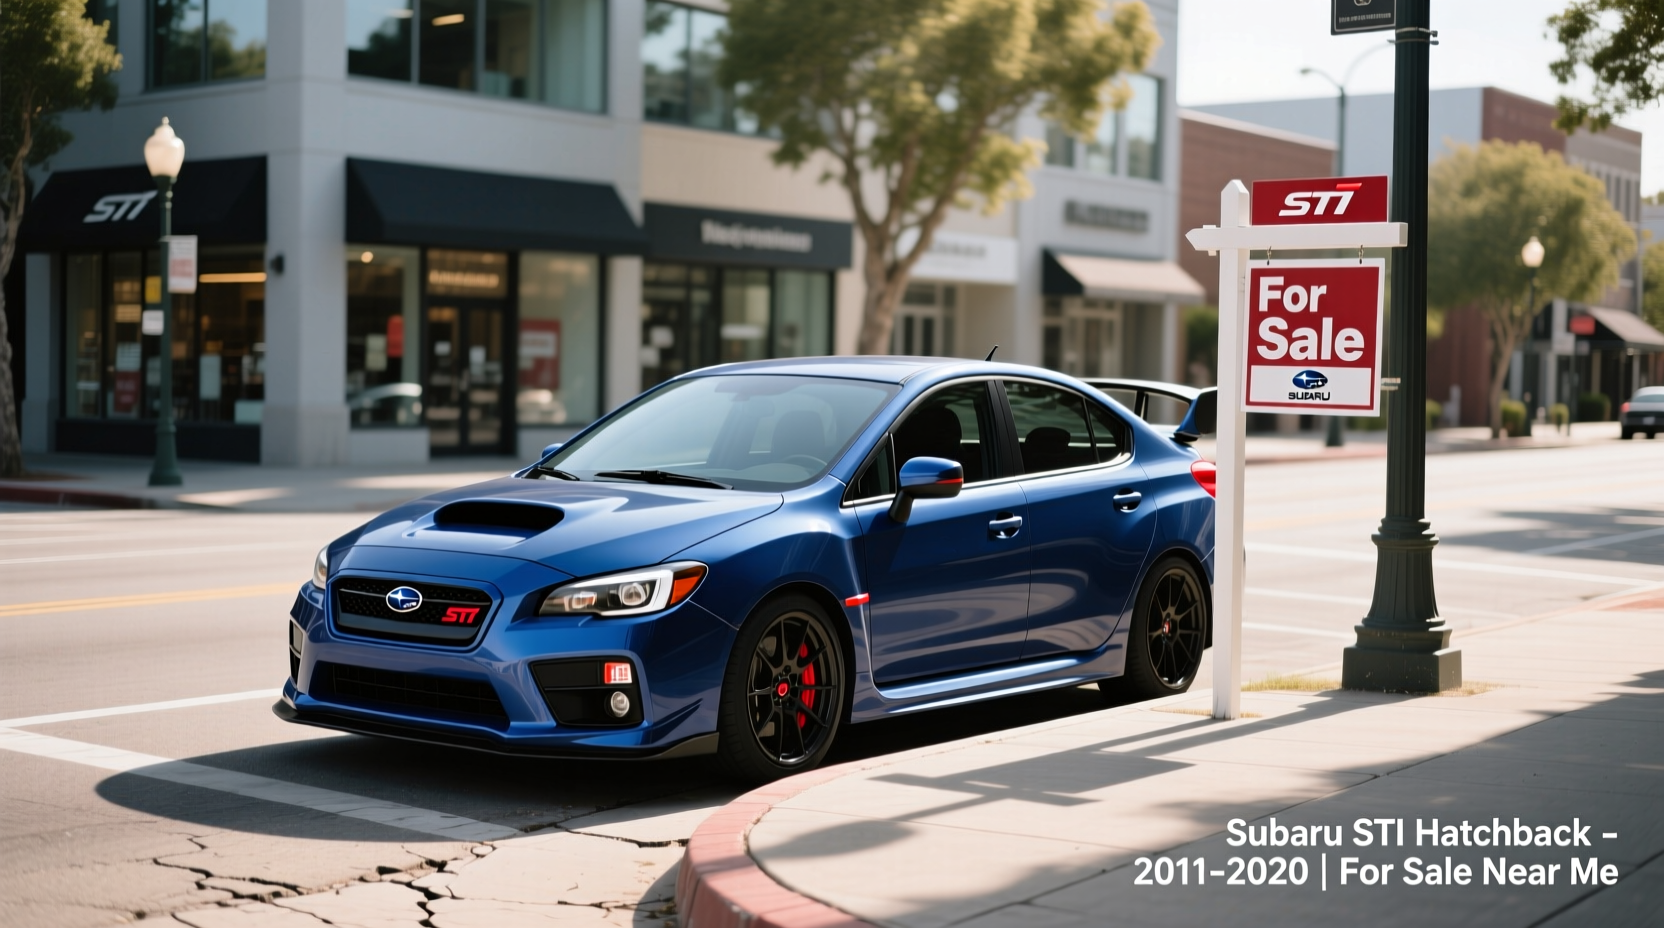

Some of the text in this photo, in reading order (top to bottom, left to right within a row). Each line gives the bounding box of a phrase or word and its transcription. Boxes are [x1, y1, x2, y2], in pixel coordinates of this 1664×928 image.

[83, 189, 158, 223] STI
[1278, 182, 1363, 217] STI
[1258, 275, 1328, 313] For
[1256, 316, 1366, 362] Sale
[1288, 391, 1331, 401] SUBARU
[441, 606, 481, 624] STI
